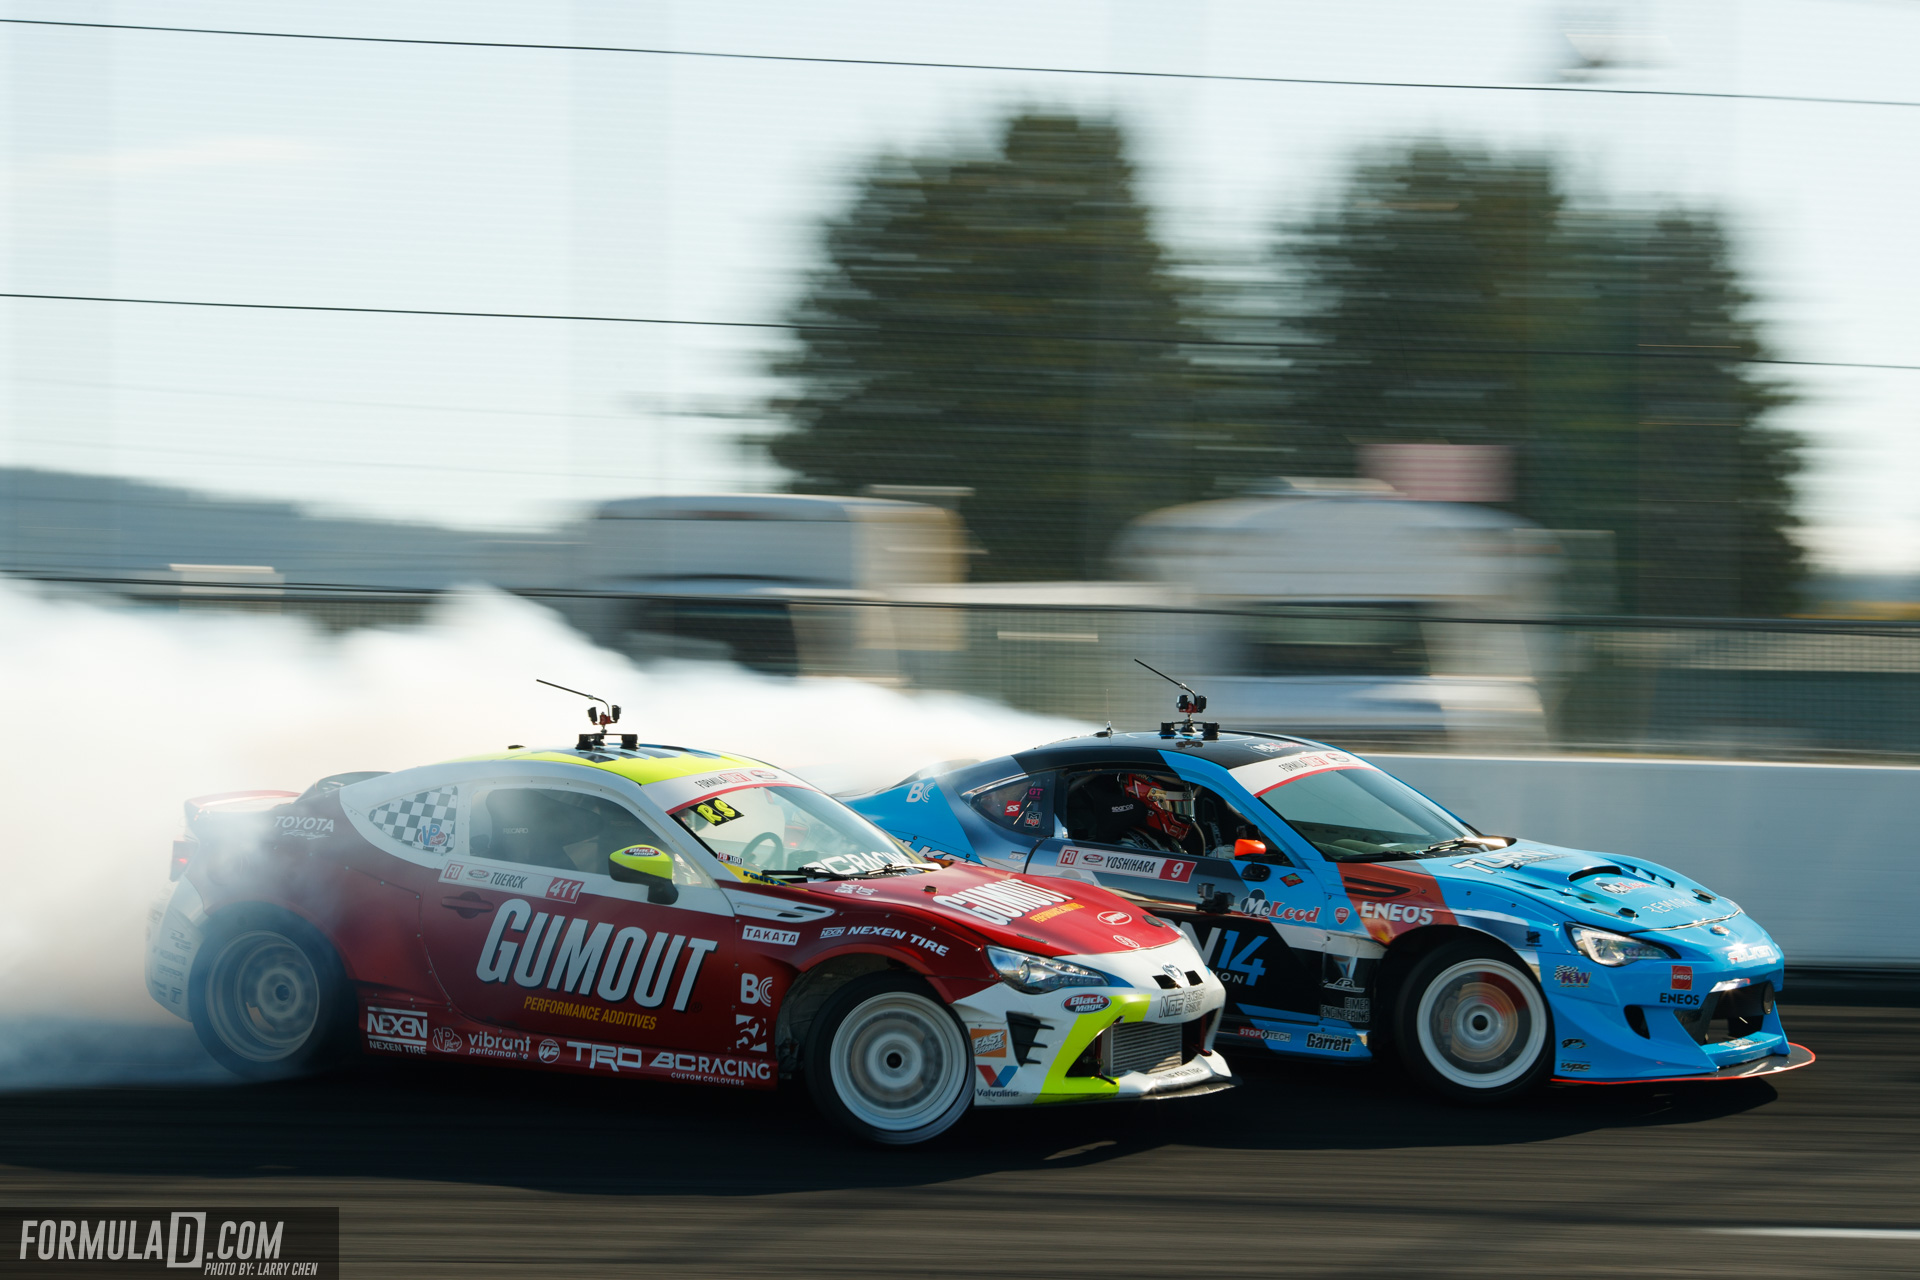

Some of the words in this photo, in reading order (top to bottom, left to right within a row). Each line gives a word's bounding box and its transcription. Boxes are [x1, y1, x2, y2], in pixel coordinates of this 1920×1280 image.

[273, 815, 335, 833] TOYOTA
[1105, 855, 1156, 873] YOSHIHARA
[1170, 862, 1184, 879] 9
[490, 872, 528, 889] TUERCK
[549, 879, 582, 900] 411
[932, 878, 1075, 926] GUMOUT
[1360, 901, 1435, 926] ENEOS
[745, 926, 797, 944] TAKATA
[847, 926, 907, 940] NEXEN
[910, 933, 950, 957] TIRE
[476, 898, 719, 1012] GUMOUT
[1070, 995, 1105, 1006] Black
[1075, 1003, 1104, 1013] Magic
[1660, 992, 1700, 1006] ENEOS
[523, 996, 601, 1021] PERFORMANCE
[601, 1008, 657, 1030] ADDITIVES
[1320, 1004, 1370, 1023] ENGINEERING
[367, 1012, 428, 1039] NEXEN
[369, 1040, 401, 1053] NEXEN
[403, 1044, 427, 1055] TIRE
[468, 1031, 531, 1052] vibrant
[1306, 1033, 1355, 1052] Garrett
[566, 1041, 643, 1072] TRD
[671, 1072, 701, 1082] CUSTOM
[703, 1076, 745, 1086] COILOVERS
[976, 1088, 1020, 1098] Valvoline
